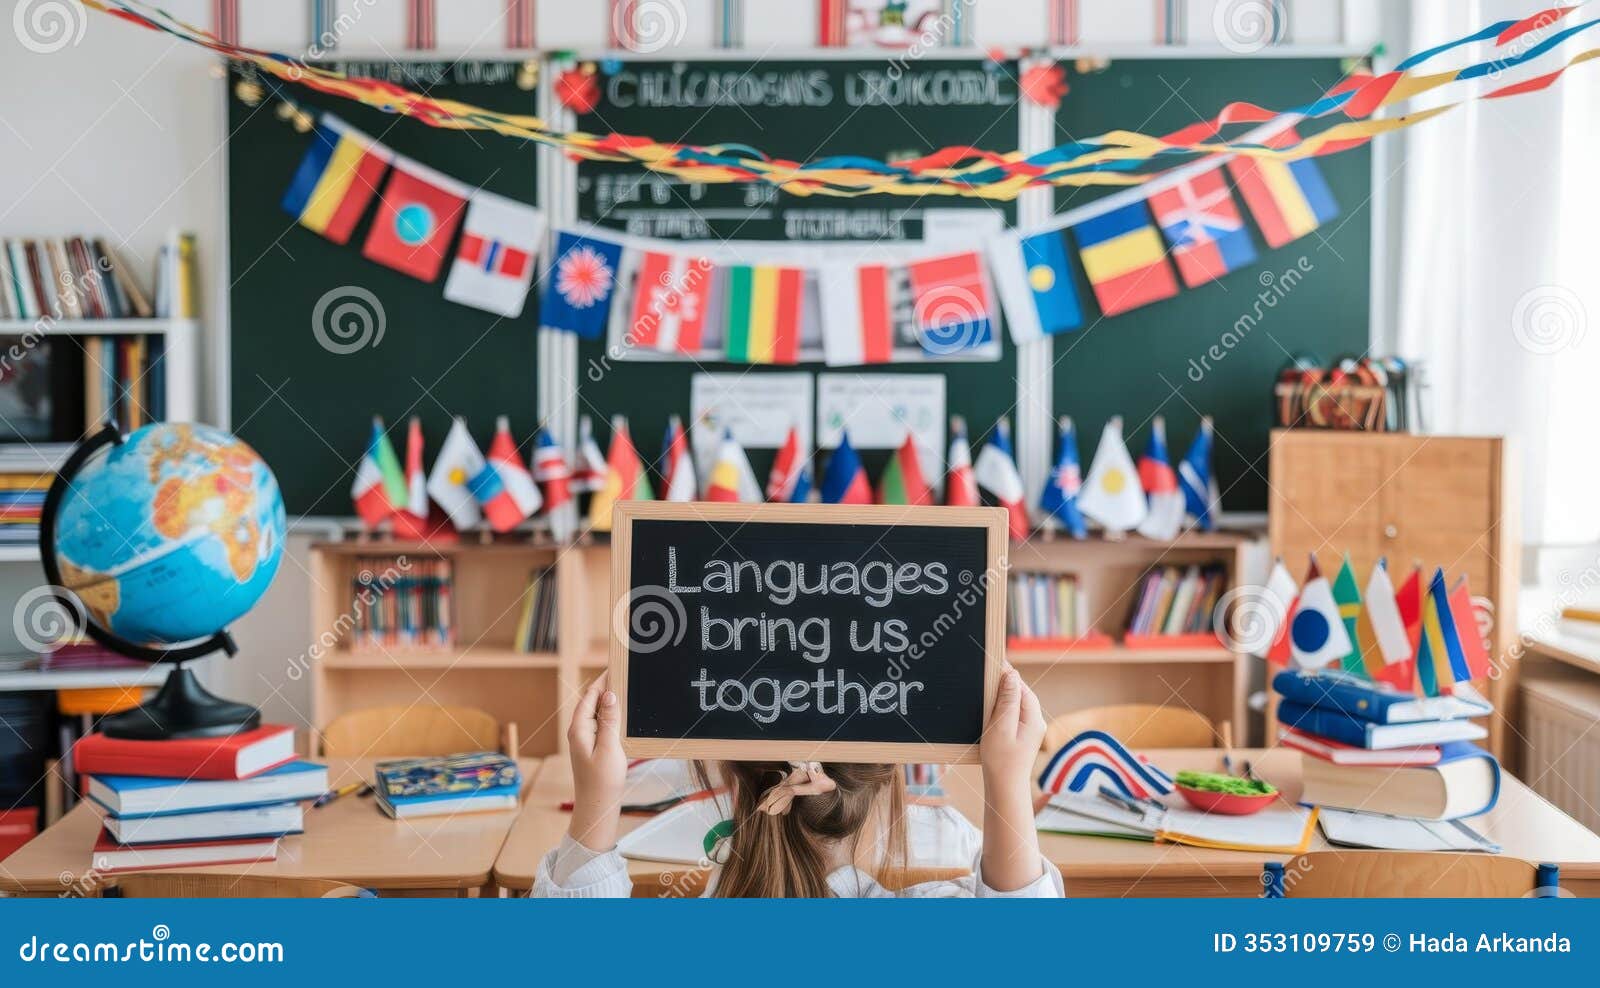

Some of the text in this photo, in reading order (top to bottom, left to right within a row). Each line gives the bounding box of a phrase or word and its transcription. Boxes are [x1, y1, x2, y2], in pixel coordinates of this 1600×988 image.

[667, 546, 950, 608] Languages
[700, 606, 910, 664] bring us
[691, 668, 924, 723] together
